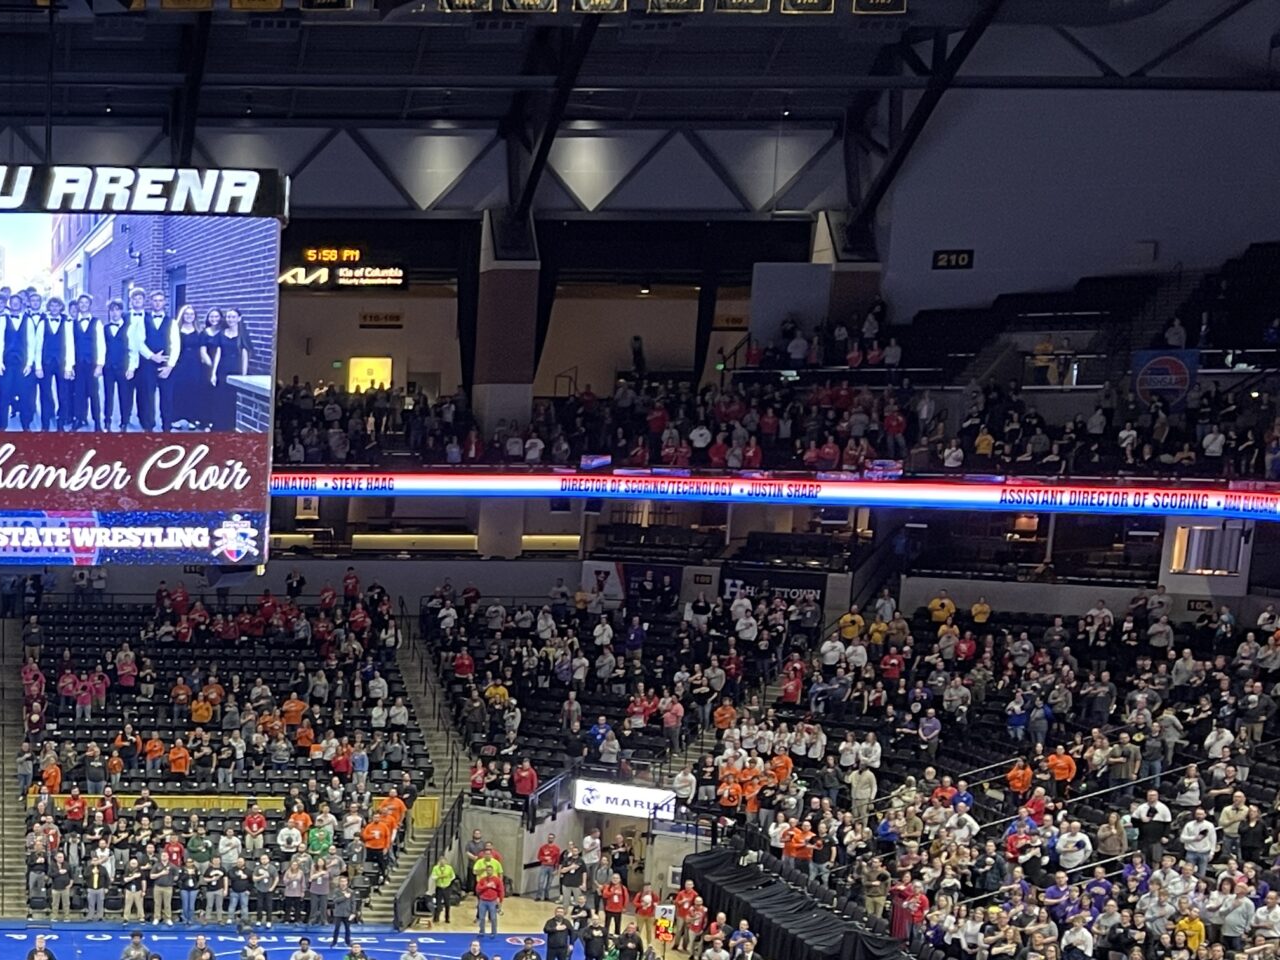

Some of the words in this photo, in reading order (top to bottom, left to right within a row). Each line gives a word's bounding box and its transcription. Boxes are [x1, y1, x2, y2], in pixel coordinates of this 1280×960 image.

[44, 168, 260, 214] ARENA
[306, 249, 338, 261] 5:58
[343, 249, 361, 261] PM
[937, 254, 968, 266] 210
[365, 267, 404, 278] Columbia
[136, 444, 252, 497] Choir
[267, 476, 317, 492] DINATOR
[331, 477, 364, 492] STEVE
[366, 477, 395, 492] HAAG
[560, 477, 607, 494] DIRECTOR
[609, 478, 622, 494] OF
[624, 478, 733, 497] SCORING/TECHNOLOGY
[746, 480, 782, 498] JUSTIN
[786, 483, 822, 500] SHARP
[999, 487, 1065, 506] ASSISTANT
[1068, 489, 1129, 508] DIRECTOR
[1132, 491, 1150, 509] OF
[1152, 491, 1210, 510] SCORING
[72, 525, 210, 549] WRESTLING
